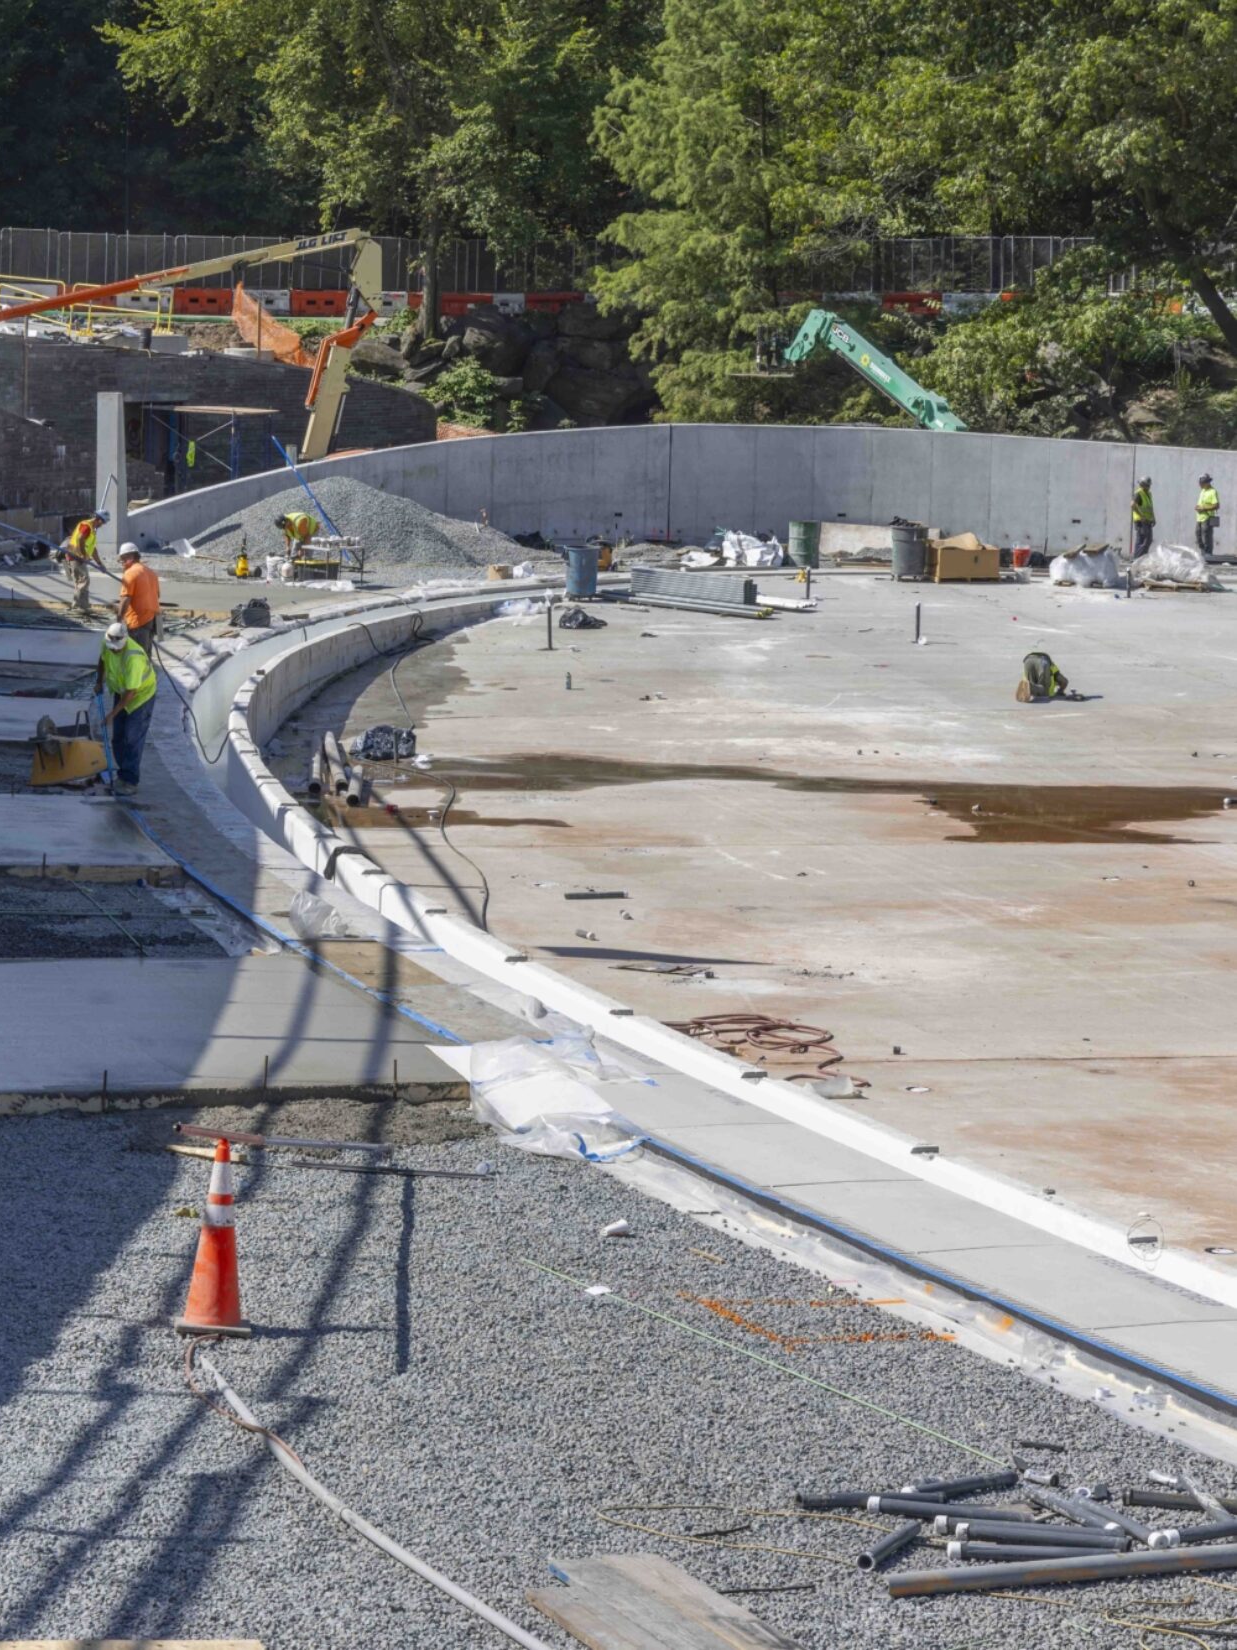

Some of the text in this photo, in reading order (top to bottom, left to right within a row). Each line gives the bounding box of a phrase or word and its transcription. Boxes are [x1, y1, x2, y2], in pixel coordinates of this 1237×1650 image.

[295, 232, 347, 250] JLG LIFT
[832, 326, 850, 343] JCB
